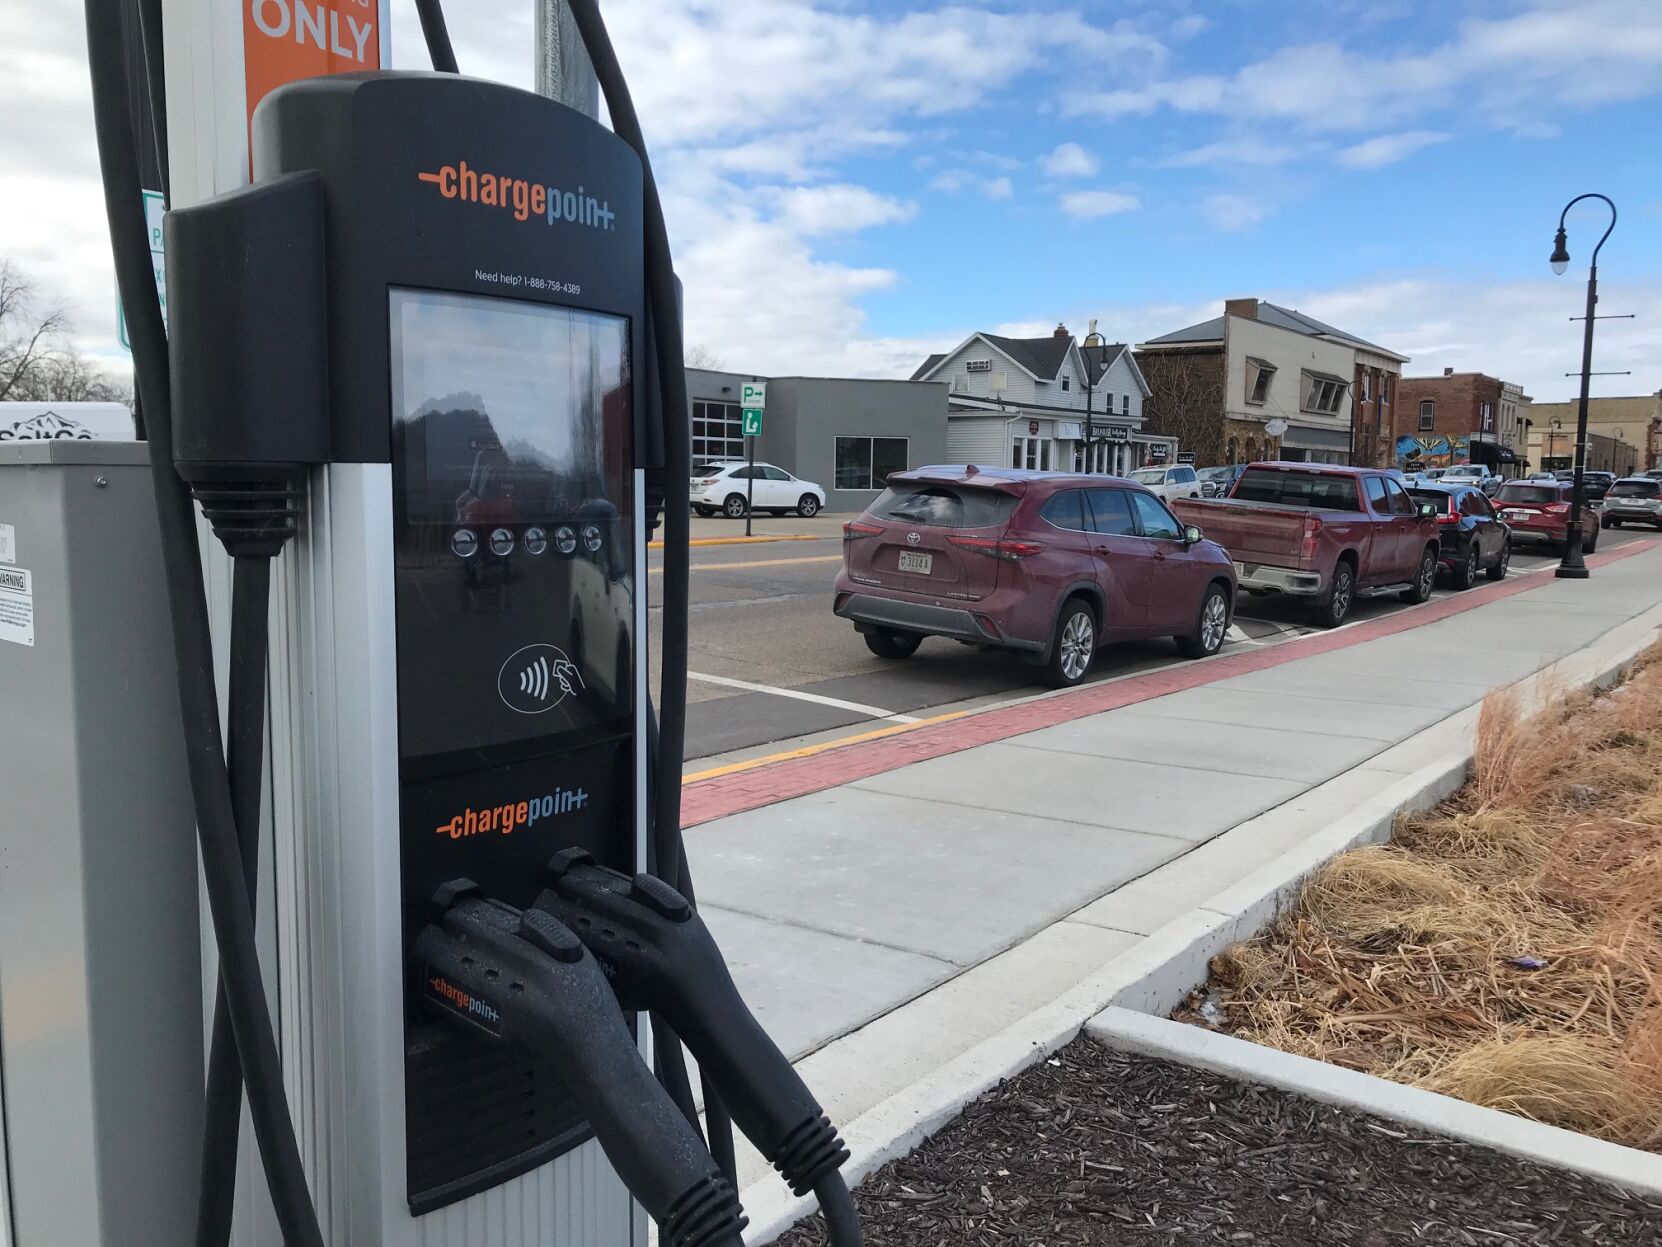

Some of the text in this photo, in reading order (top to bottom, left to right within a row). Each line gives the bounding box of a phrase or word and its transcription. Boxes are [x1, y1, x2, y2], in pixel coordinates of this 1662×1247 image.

[252, 0, 372, 63] ONLY
[418, 160, 615, 231] chargepoint
[475, 269, 581, 295] Need help? 1-888-758-4389
[744, 386, 754, 404] P
[436, 786, 588, 840] chargepoint
[429, 977, 500, 1022] chargepoint
